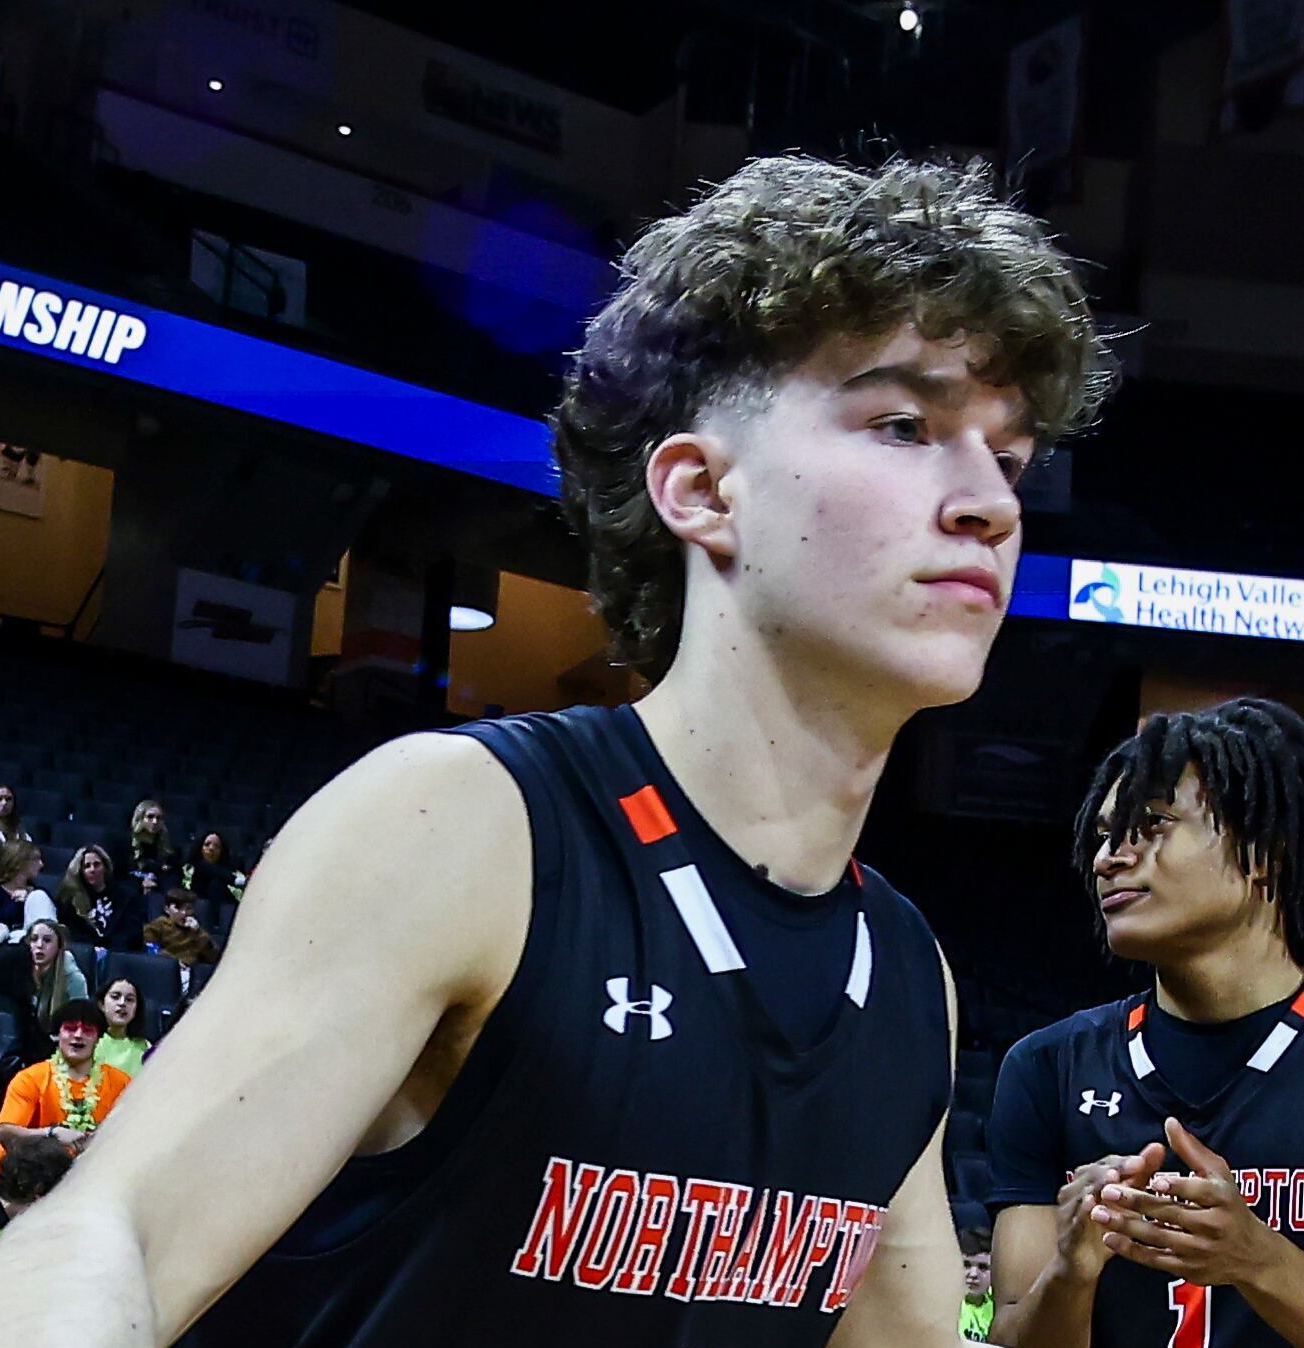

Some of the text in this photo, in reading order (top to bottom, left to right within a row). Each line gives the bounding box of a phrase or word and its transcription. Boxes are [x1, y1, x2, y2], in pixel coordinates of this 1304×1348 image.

[1138, 571, 1231, 603] Lehigh
[1136, 601, 1225, 633] Health
[508, 1155, 891, 1315] NORTHAMPT
